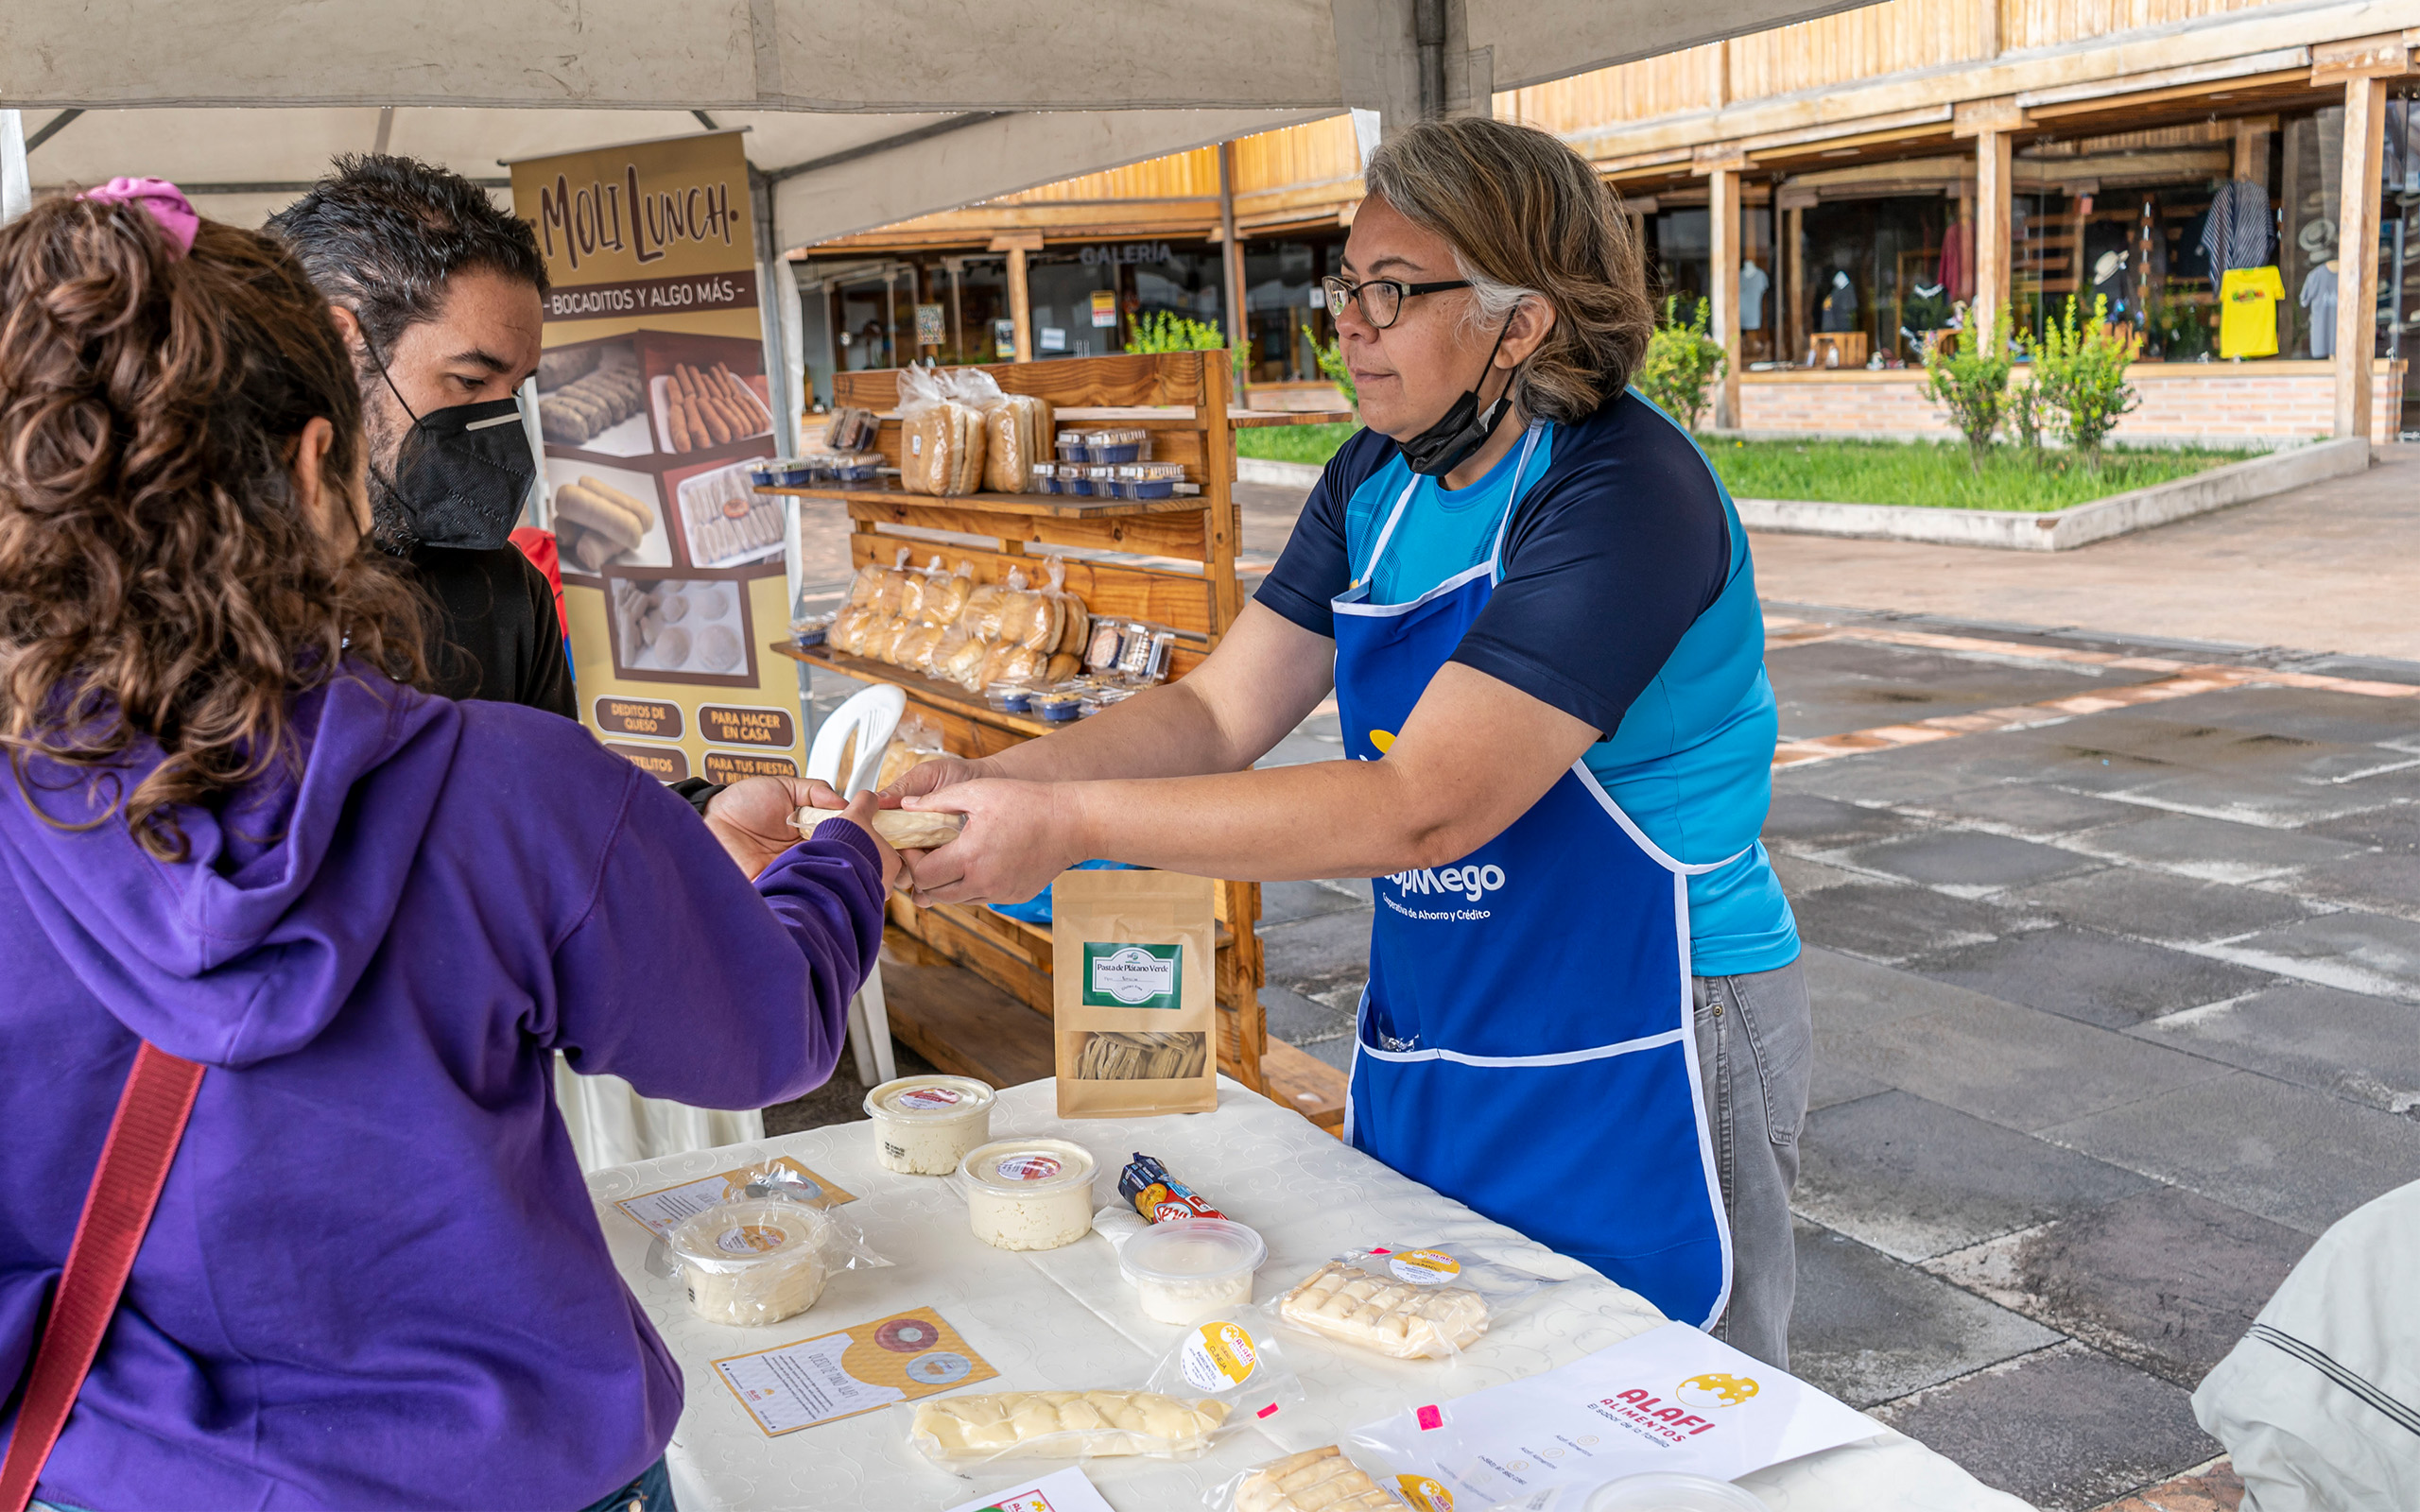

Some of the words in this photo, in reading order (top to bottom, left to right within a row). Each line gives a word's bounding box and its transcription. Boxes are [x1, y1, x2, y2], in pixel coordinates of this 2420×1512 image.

[542, 174, 624, 269] MOLI
[628, 164, 732, 264] LUNCH
[1080, 241, 1172, 265] GALERÍA
[552, 289, 633, 315] BOCADITOS
[636, 287, 646, 307] Y
[650, 285, 693, 307] ALGO
[696, 277, 735, 303] MÁS
[611, 703, 650, 719] DEDITOS
[651, 706, 666, 720] DE
[711, 711, 739, 726] PARA
[741, 713, 780, 729] HACER
[624, 718, 658, 732] QUESO
[722, 726, 739, 740] EN
[741, 728, 771, 742] CASA
[708, 757, 735, 770] PARA
[735, 759, 754, 773] TUS
[755, 762, 795, 776] FIESTAS
[717, 771, 724, 783] Y
[1409, 908, 1417, 919] de
[1418, 910, 1449, 919] Ahorro
[1450, 911, 1455, 922] y
[1457, 909, 1491, 920] Crédito
[1097, 963, 1115, 971] Pasta
[1124, 964, 1150, 972] Plátano
[1210, 1346, 1227, 1370] CLINEJA
[1236, 1338, 1254, 1363] ALAFI
[1600, 1398, 1686, 1442] ALIMENTOS
[1616, 1389, 1716, 1435] ALAFI
[1596, 1408, 1621, 1422] sabor
[1641, 1432, 1670, 1448] familia
